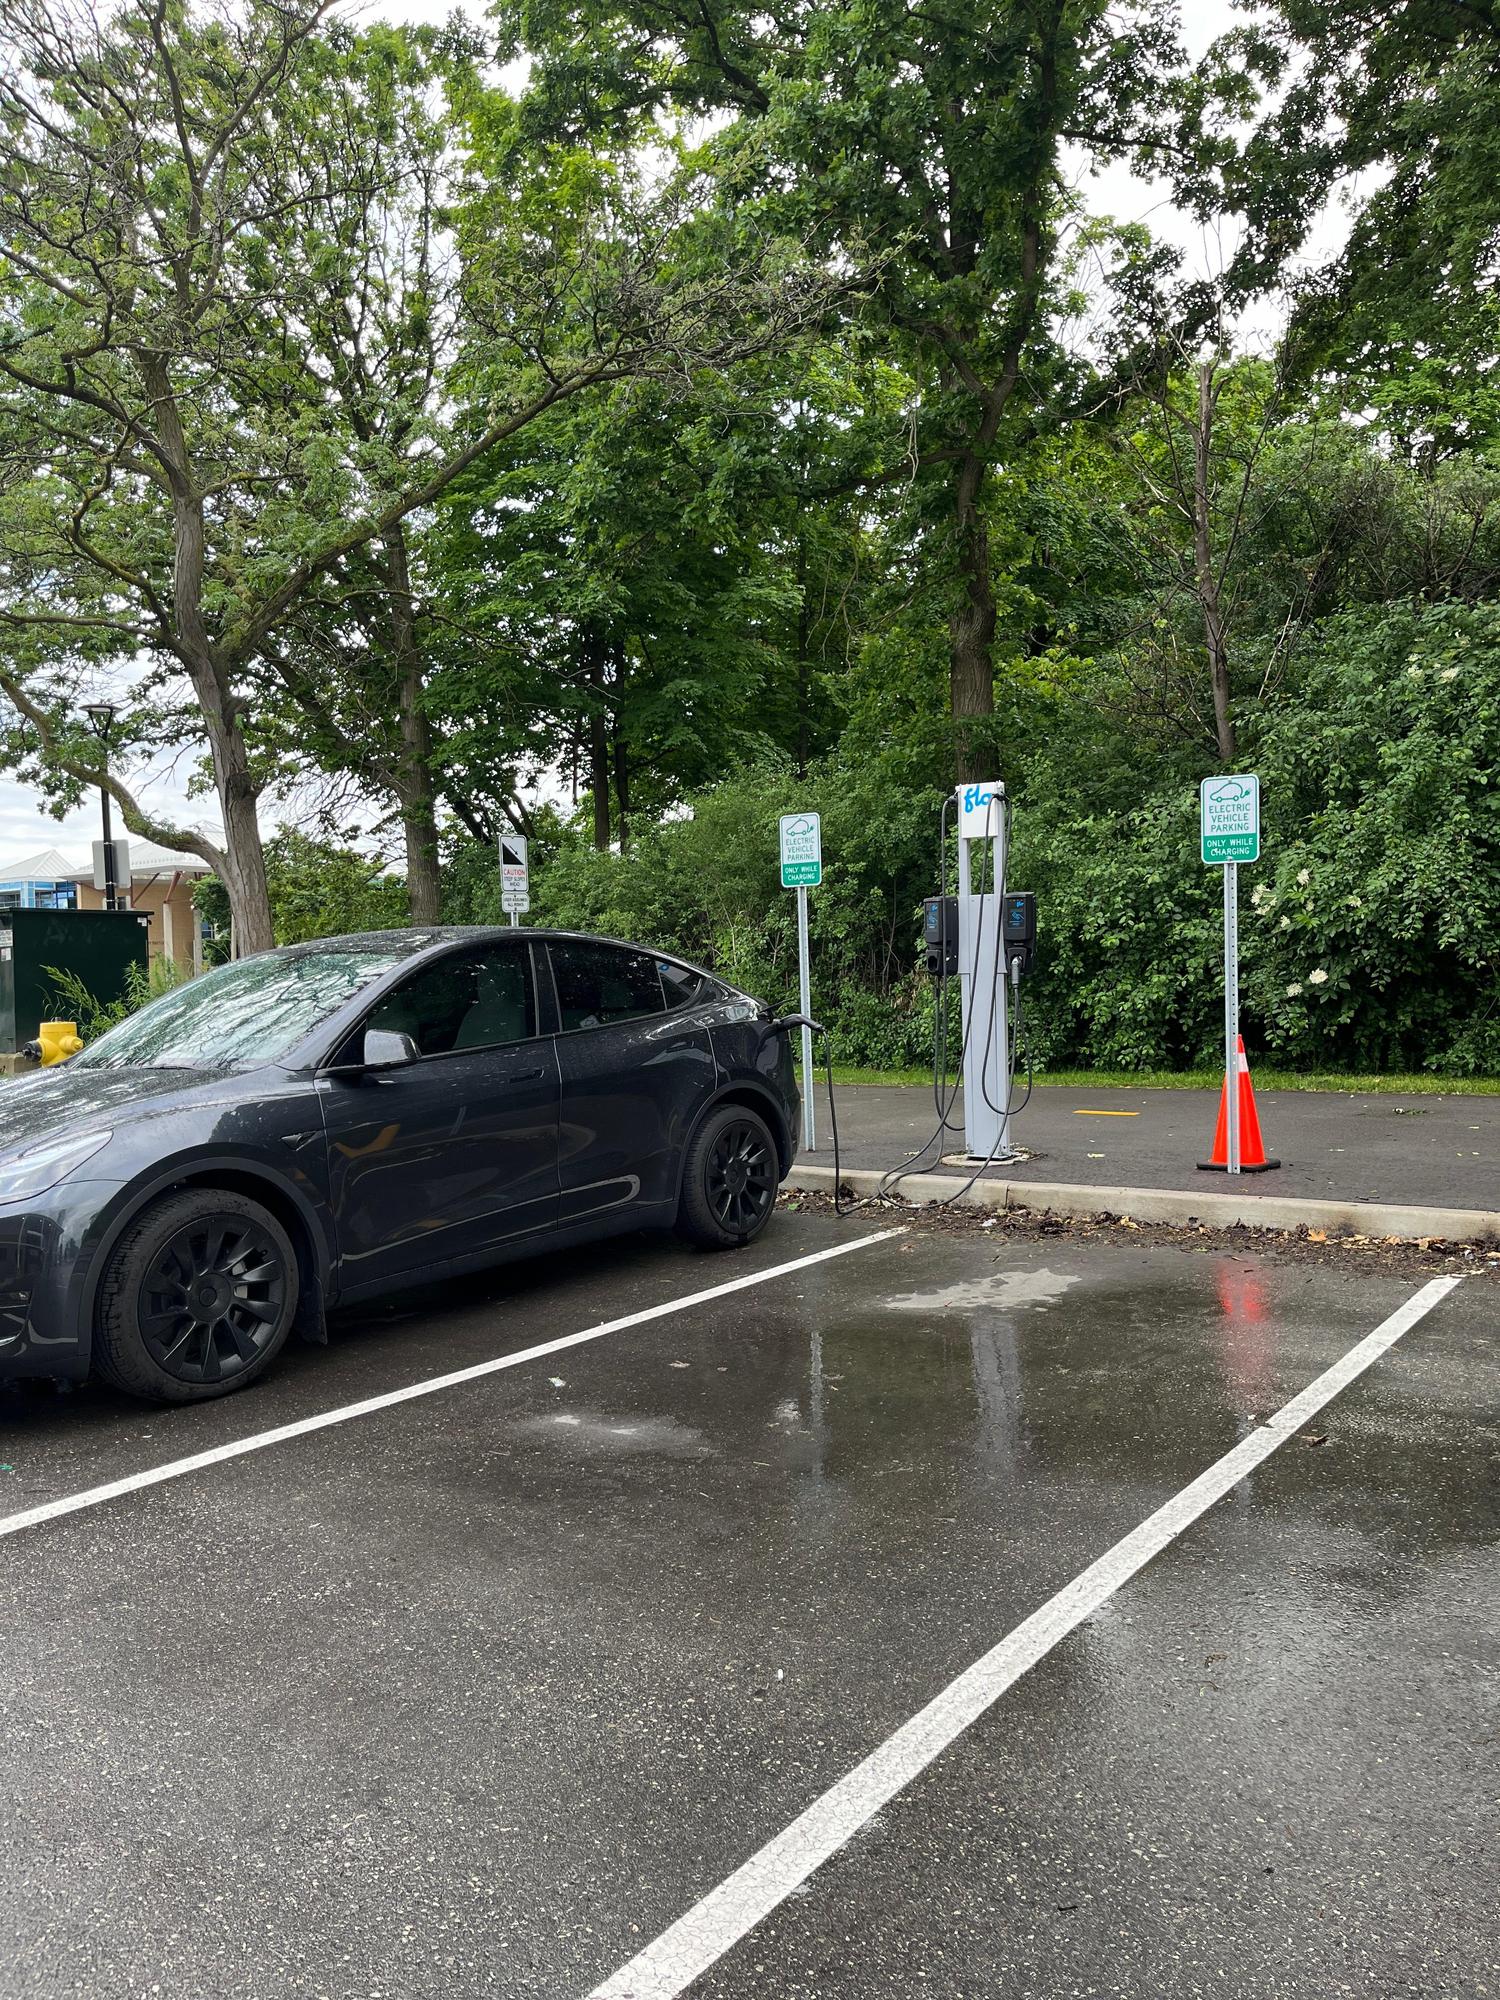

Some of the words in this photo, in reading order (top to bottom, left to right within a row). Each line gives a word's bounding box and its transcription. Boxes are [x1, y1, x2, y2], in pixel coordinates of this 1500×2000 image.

[964, 784, 993, 813] flo
[1208, 803, 1251, 814] ELECTRIC
[1211, 813, 1249, 823] VEHICLE
[1210, 823, 1249, 832] PARKING
[785, 837, 815, 846] ELECTRIC
[1206, 839, 1226, 847] ONLY
[1229, 837, 1254, 846] WHILE
[787, 845, 814, 853] VEHICLE
[1210, 847, 1250, 856] CHARGING
[787, 853, 814, 861] PARKING
